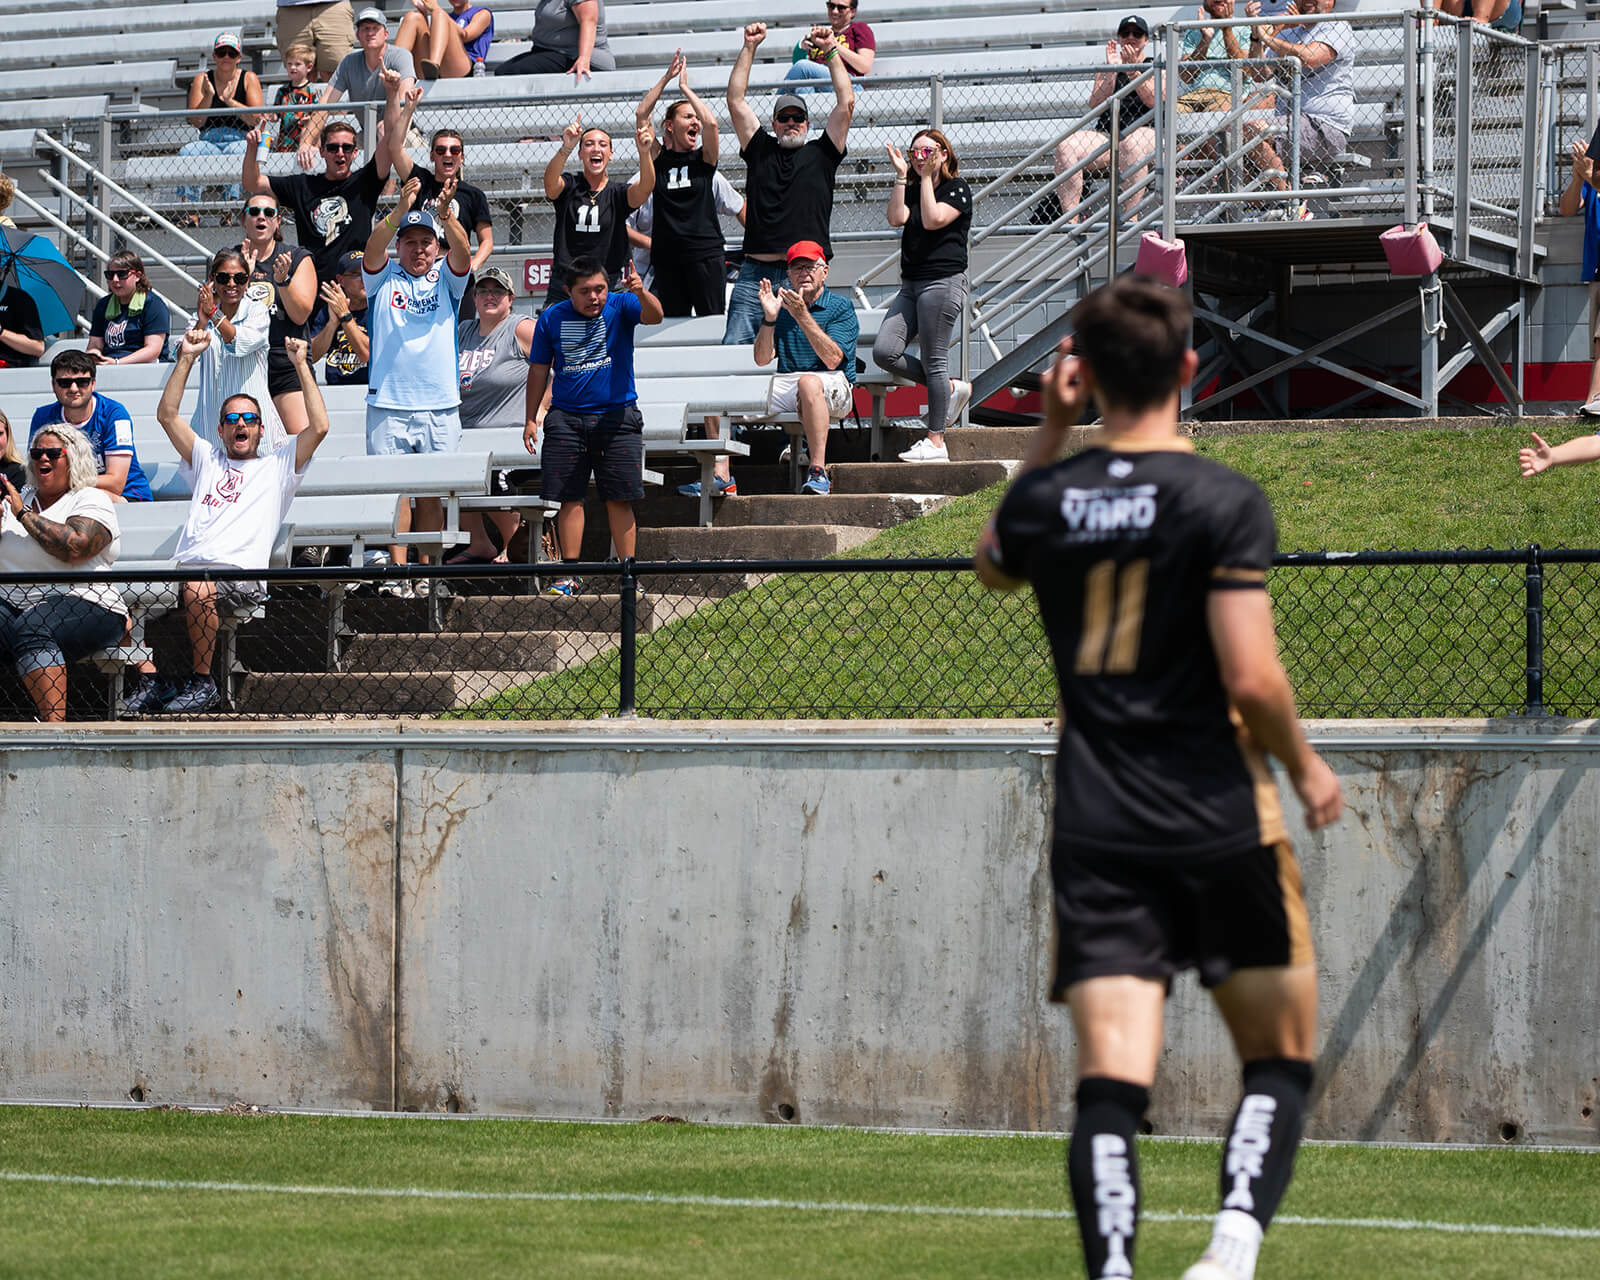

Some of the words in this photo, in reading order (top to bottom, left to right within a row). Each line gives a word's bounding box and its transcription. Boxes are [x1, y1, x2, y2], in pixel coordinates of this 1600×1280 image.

[667, 165, 691, 189] 11
[576, 204, 600, 232] 11
[528, 264, 551, 285] SE
[459, 348, 496, 372] UBS
[1061, 497, 1157, 530] YARD
[1074, 558, 1150, 675] 11
[1224, 1094, 1277, 1211] PEORIA
